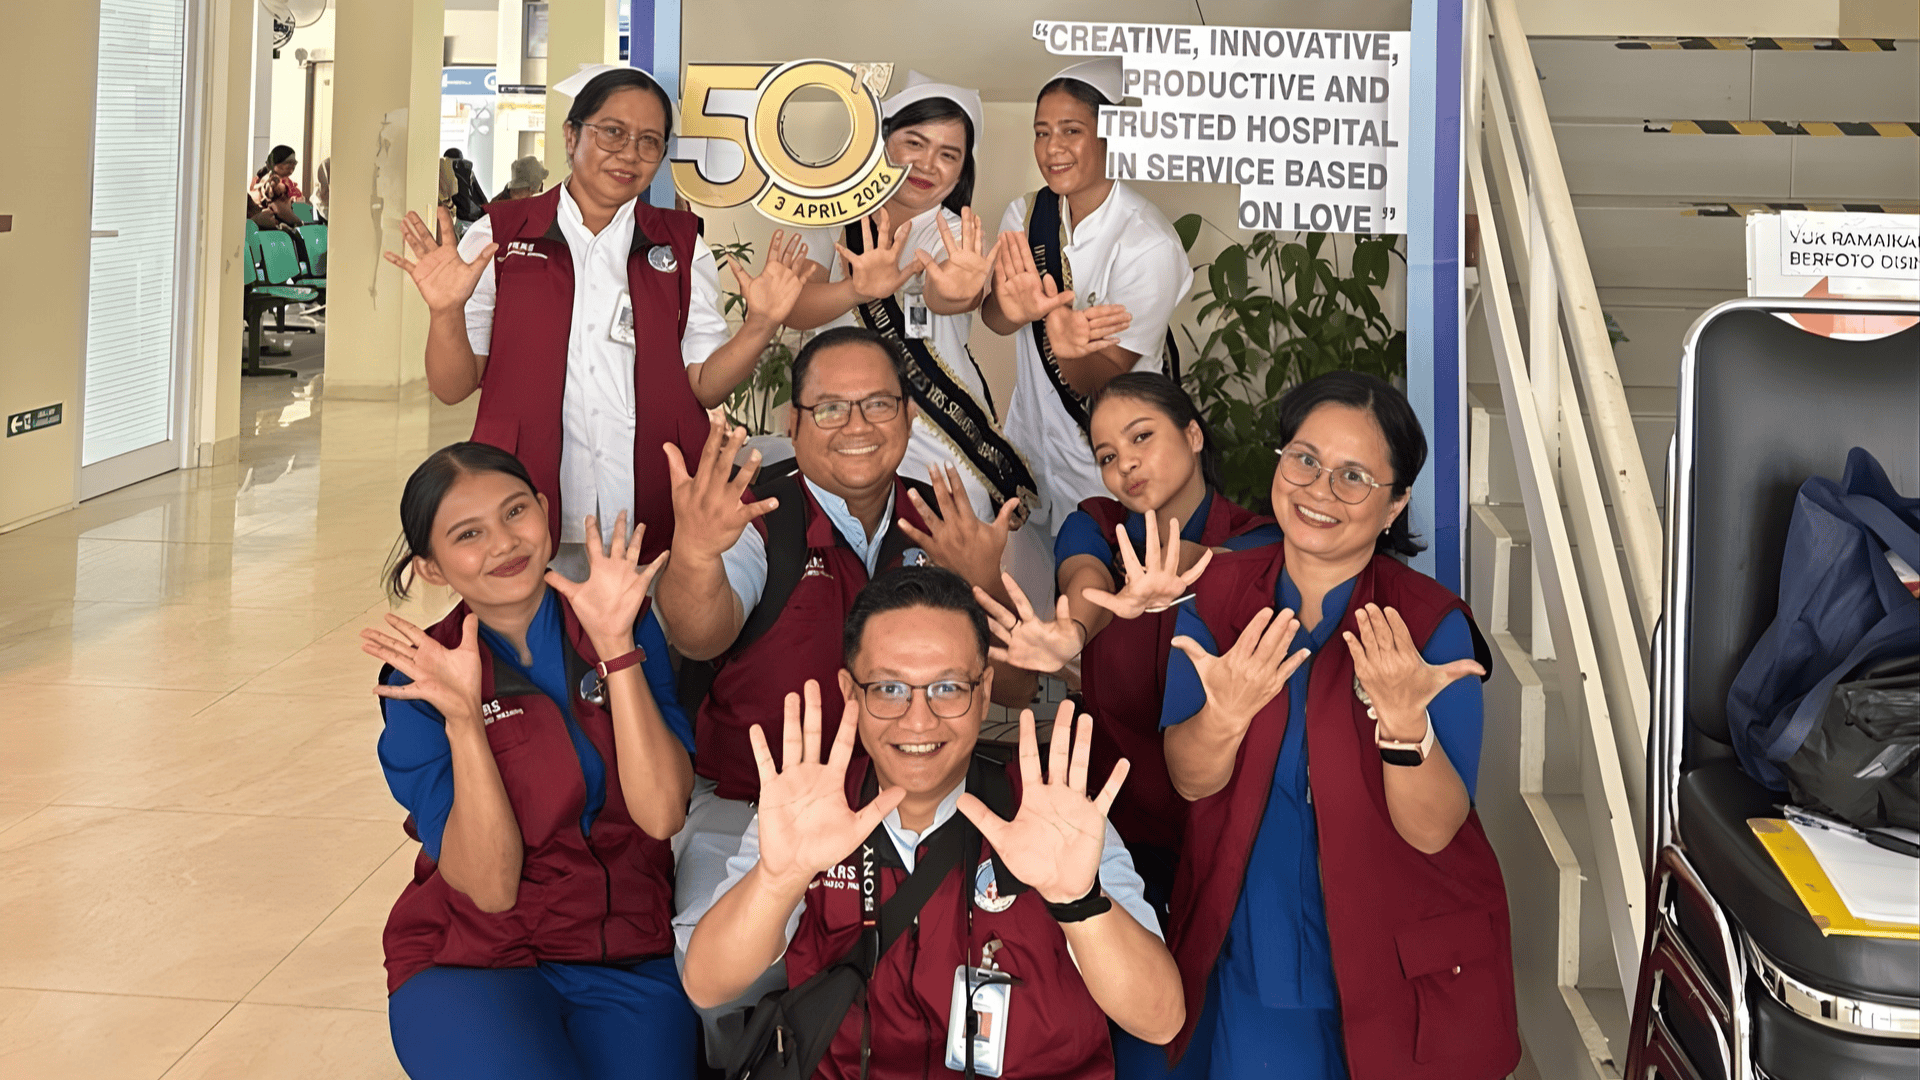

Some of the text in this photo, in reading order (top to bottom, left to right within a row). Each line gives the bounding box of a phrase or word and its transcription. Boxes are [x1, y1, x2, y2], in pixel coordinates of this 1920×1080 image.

[1210, 29, 1399, 66] INNOVATIVE,
[1124, 69, 1390, 103] PRODUCTIVE AND
[1100, 109, 1399, 147] TRUSTED HOSPITAL
[1108, 152, 1387, 190] IN SERVICE BASED
[774, 172, 891, 218] 3 APRIL 2026
[1240, 201, 1282, 229] ON
[1790, 230, 1920, 249] YUK RAMAIKA
[1790, 251, 1874, 269] BERFOTO
